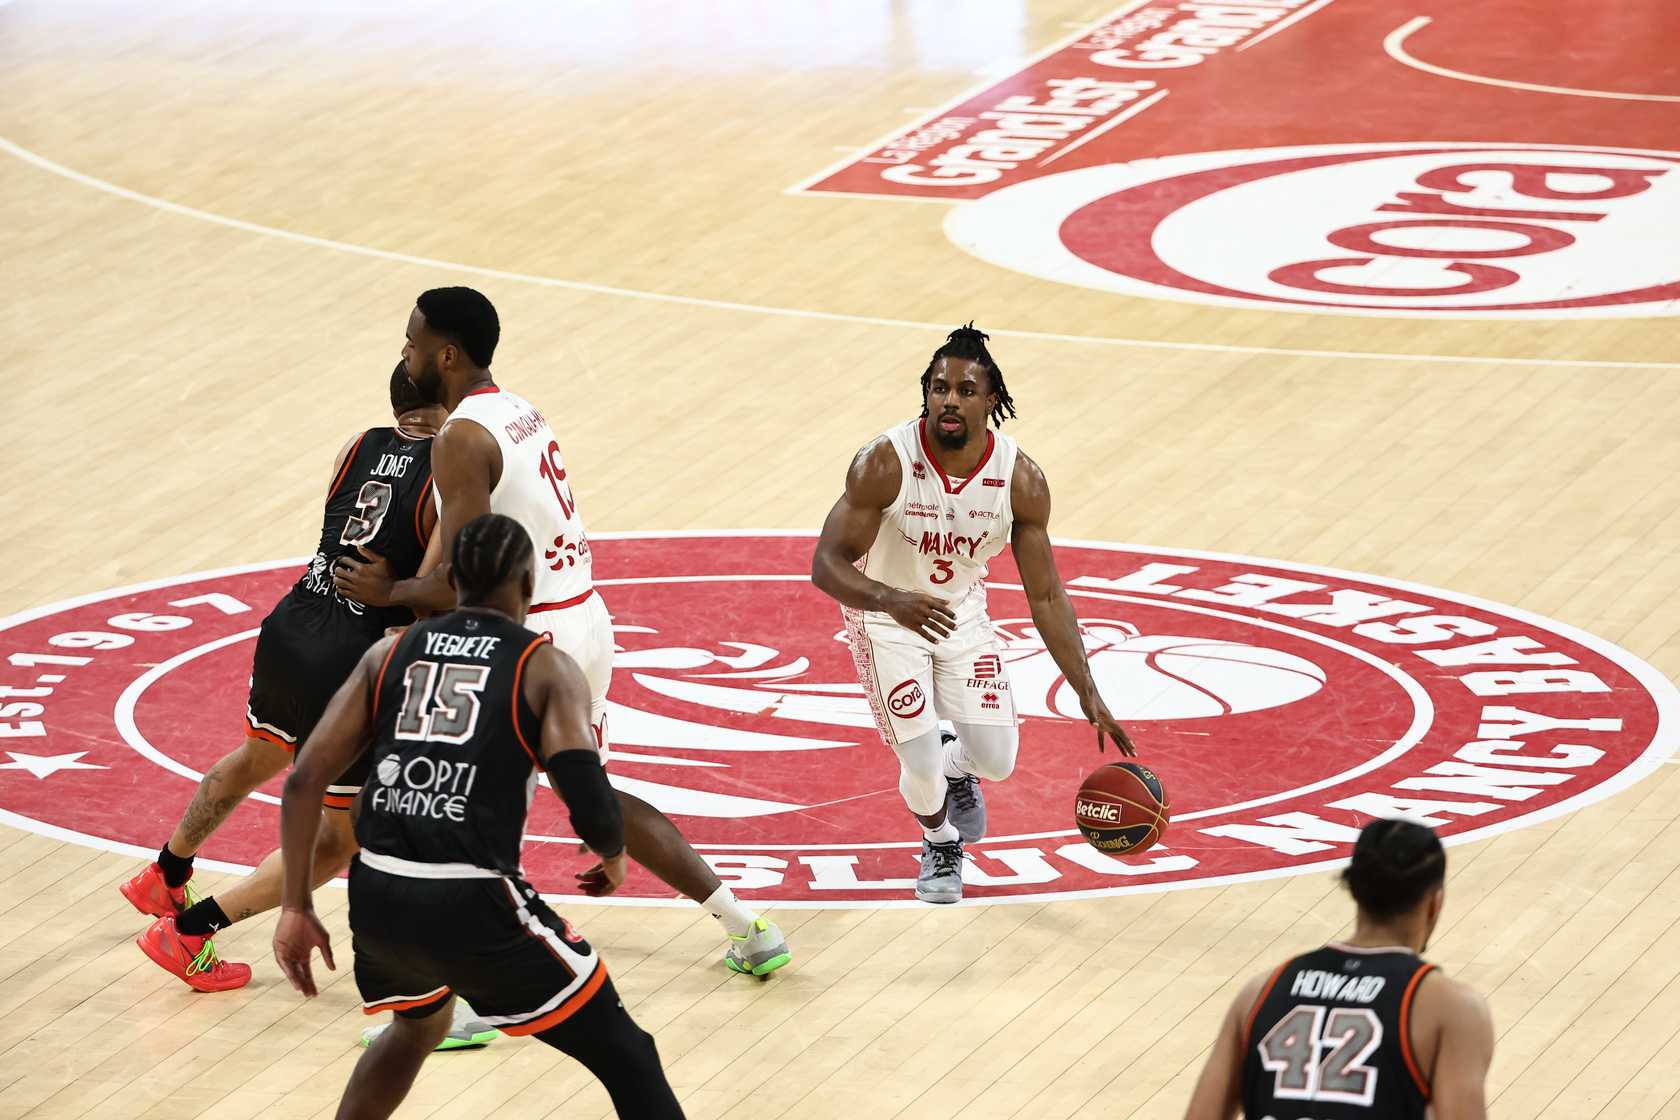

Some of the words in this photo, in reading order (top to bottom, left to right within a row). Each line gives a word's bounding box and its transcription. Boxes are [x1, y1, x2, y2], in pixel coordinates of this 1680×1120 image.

[1267, 163, 1670, 297] cora
[370, 453, 413, 478] JONES
[339, 480, 392, 545] 3
[919, 531, 984, 558] NANCY
[929, 559, 954, 584] 3
[424, 632, 500, 660] YEGUETE
[1066, 562, 1613, 696] BASKET
[891, 686, 922, 711] cora
[966, 678, 1009, 690] EIFFAGE
[395, 660, 491, 744] 15
[404, 756, 477, 796] OPTI
[1196, 706, 1623, 856] NANCY
[1076, 800, 1118, 821] Betclic
[1289, 969, 1387, 1003] HOWARD
[1257, 1005, 1384, 1107] 42
